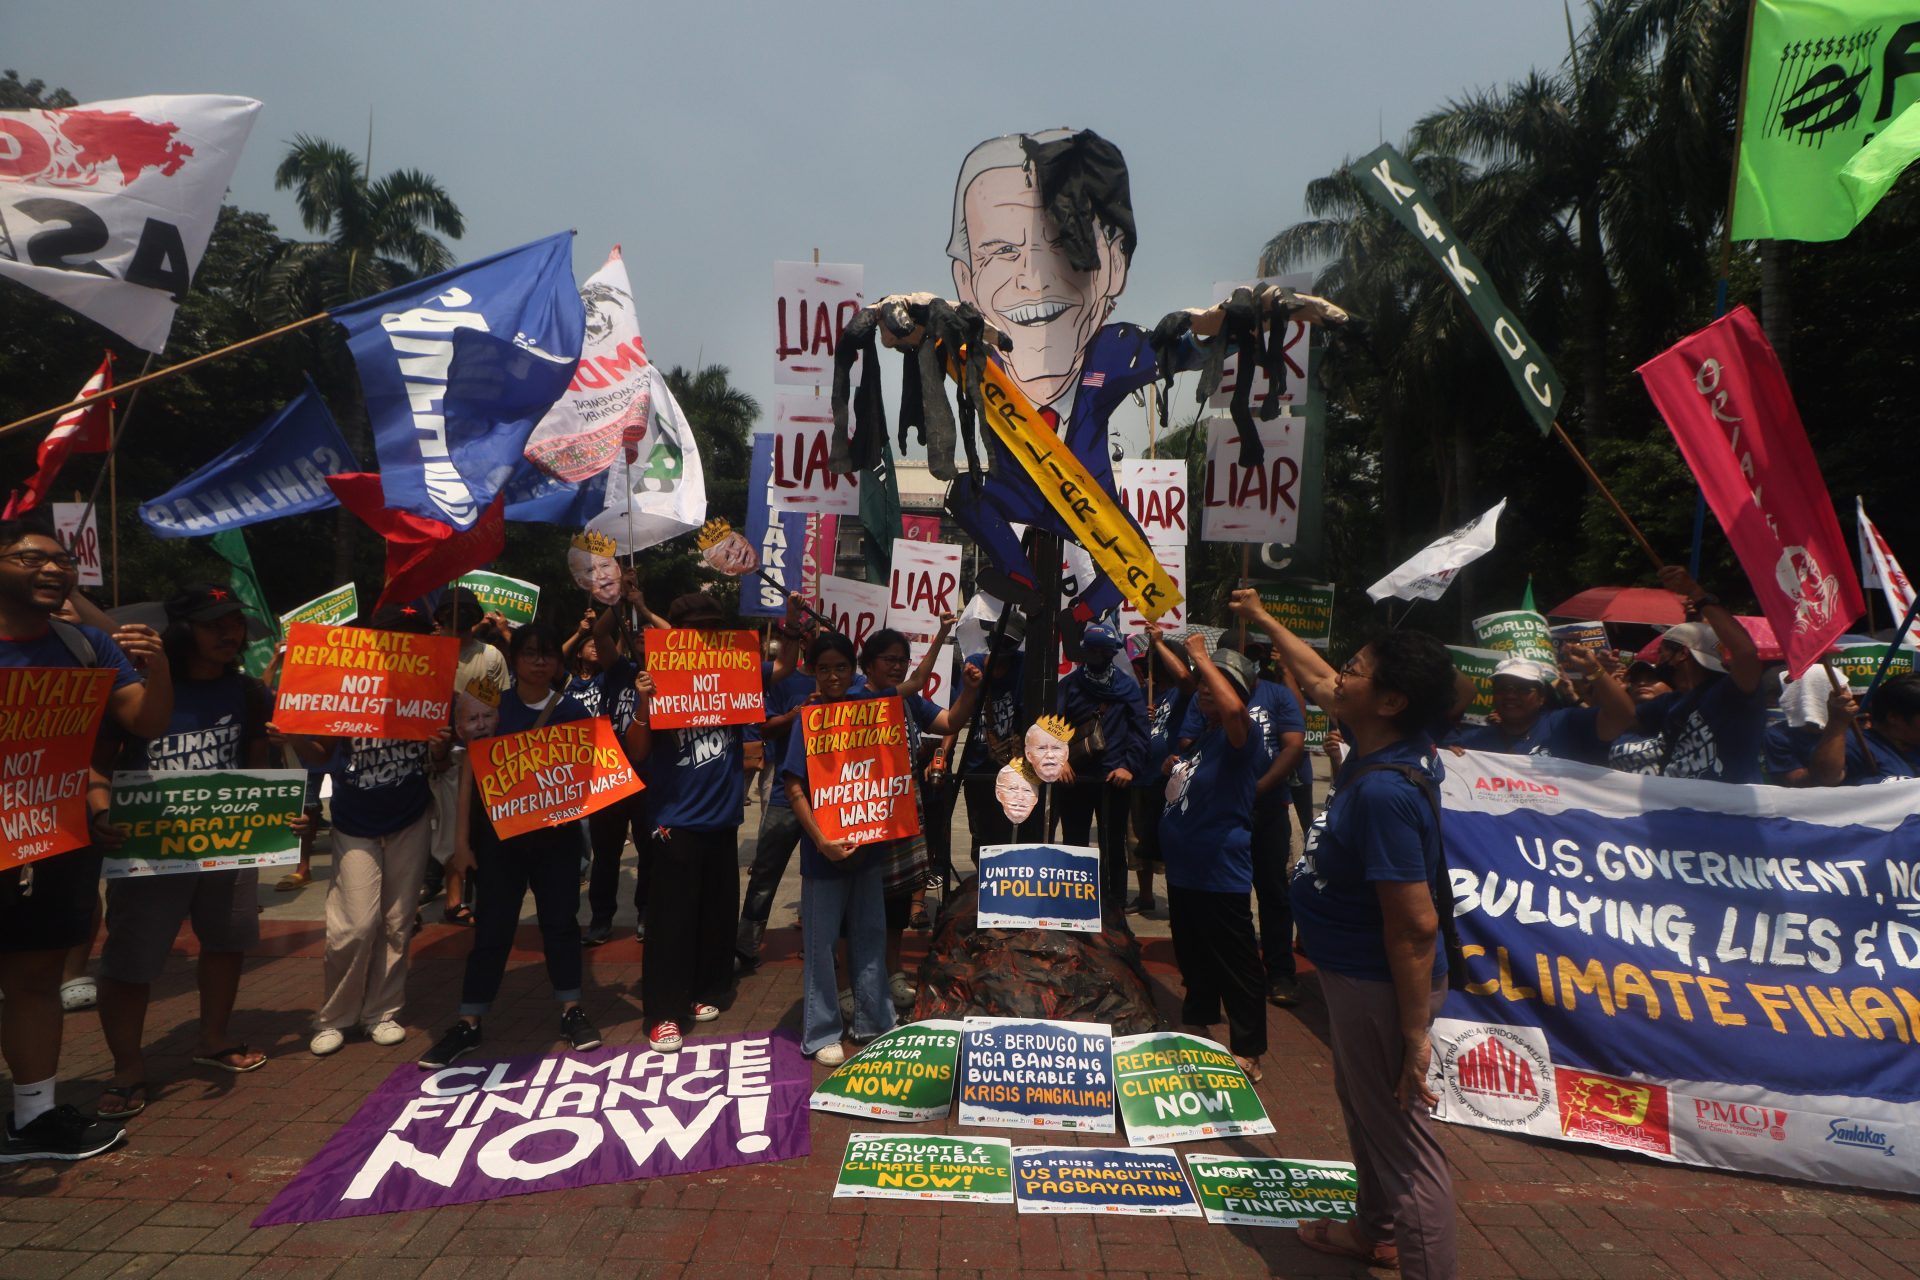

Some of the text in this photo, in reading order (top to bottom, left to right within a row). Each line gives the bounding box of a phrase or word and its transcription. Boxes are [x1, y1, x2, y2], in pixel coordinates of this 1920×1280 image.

[1203, 456, 1299, 517] LIAR
[1025, 440, 1097, 523] LIAR
[1091, 530, 1165, 608] LIAR
[890, 569, 957, 617] LIAR
[326, 628, 416, 654] CLIMATE
[665, 630, 737, 651] CLIMATE
[646, 651, 757, 673] REPARATIONS,
[1831, 656, 1875, 666] UNITED
[340, 674, 384, 695] NOT
[692, 673, 721, 693] NOT
[279, 693, 449, 720] IMPERIALIST WARS!
[648, 692, 728, 716] IMPERIALIST
[729, 691, 764, 710] WARS!
[808, 701, 891, 733] CLIMATE
[147, 723, 241, 760] CLIMATE
[1047, 726, 1062, 737] KING
[490, 724, 594, 766] CLIMATE
[3, 748, 46, 779] NOT
[839, 757, 876, 783] NOT
[534, 763, 575, 790] NOT
[0, 768, 89, 811] ERIALIST
[116, 785, 302, 806] UNITED STATES
[490, 767, 634, 821] IMPERIALIST WARS!
[812, 774, 913, 810] IMPERIALIST
[161, 802, 260, 816] PAY YOUR
[839, 798, 895, 828] WARS!
[0, 805, 59, 842] WARS!
[112, 811, 298, 838] REPARATIONS
[160, 829, 254, 856] NOW!
[985, 866, 1094, 883] UNITED STATES:
[1515, 835, 1595, 883] U.S.
[1595, 841, 1885, 906] GOVERNMENT,
[1000, 880, 1097, 901] POLLUTER
[1446, 867, 1710, 975] BULLYING,
[1716, 906, 1842, 975] LIES
[1854, 921, 1886, 981] &
[1461, 944, 1747, 1028] CLIMATE
[895, 1035, 956, 1048] STATES
[1004, 1033, 1077, 1053] BERDUGO
[1083, 1037, 1105, 1053] NG
[1444, 1043, 1459, 1070] METRO
[1483, 1026, 1524, 1046] VENDORS
[1523, 1044, 1551, 1082] ALLIANCE
[421, 1036, 771, 1097] CLIMATE
[859, 1049, 922, 1061] PAY YOUR
[968, 1051, 1102, 1072] MGA BANSANG
[1116, 1049, 1236, 1072] REPARATIONS
[1457, 1035, 1539, 1097] MMVA
[968, 1068, 1106, 1085] BULNERABLE SA
[1177, 1063, 1197, 1074] FOR
[844, 1076, 914, 1101] NOW!
[964, 1084, 1111, 1109] KRISIS PANGKLIMA!
[1122, 1073, 1247, 1097] CLIMATE DEBT
[387, 1064, 773, 1134] FINANCE
[1153, 1090, 1234, 1120] NOW!
[1466, 1103, 1485, 1119] mga
[1485, 1115, 1515, 1127] vendor
[1826, 1118, 1887, 1146] Sanlakas
[339, 1094, 772, 1202] NOW!
[849, 1151, 991, 1164] PREDICTABLE
[851, 1141, 984, 1155] ADEQUATE &
[844, 1161, 1009, 1177] CLIMATE FINANCE
[1020, 1167, 1185, 1182] US PANAGUTIN!
[1022, 1159, 1042, 1167] SA
[1048, 1159, 1094, 1167] KRISIS
[1125, 1161, 1172, 1170] KLIMA:
[1196, 1164, 1357, 1182] WORLD BANK
[876, 1172, 973, 1190] NOW!
[1026, 1180, 1181, 1198] PAGBAYARIN!
[1202, 1183, 1257, 1199] LOSS
[1259, 1189, 1291, 1199] AND
